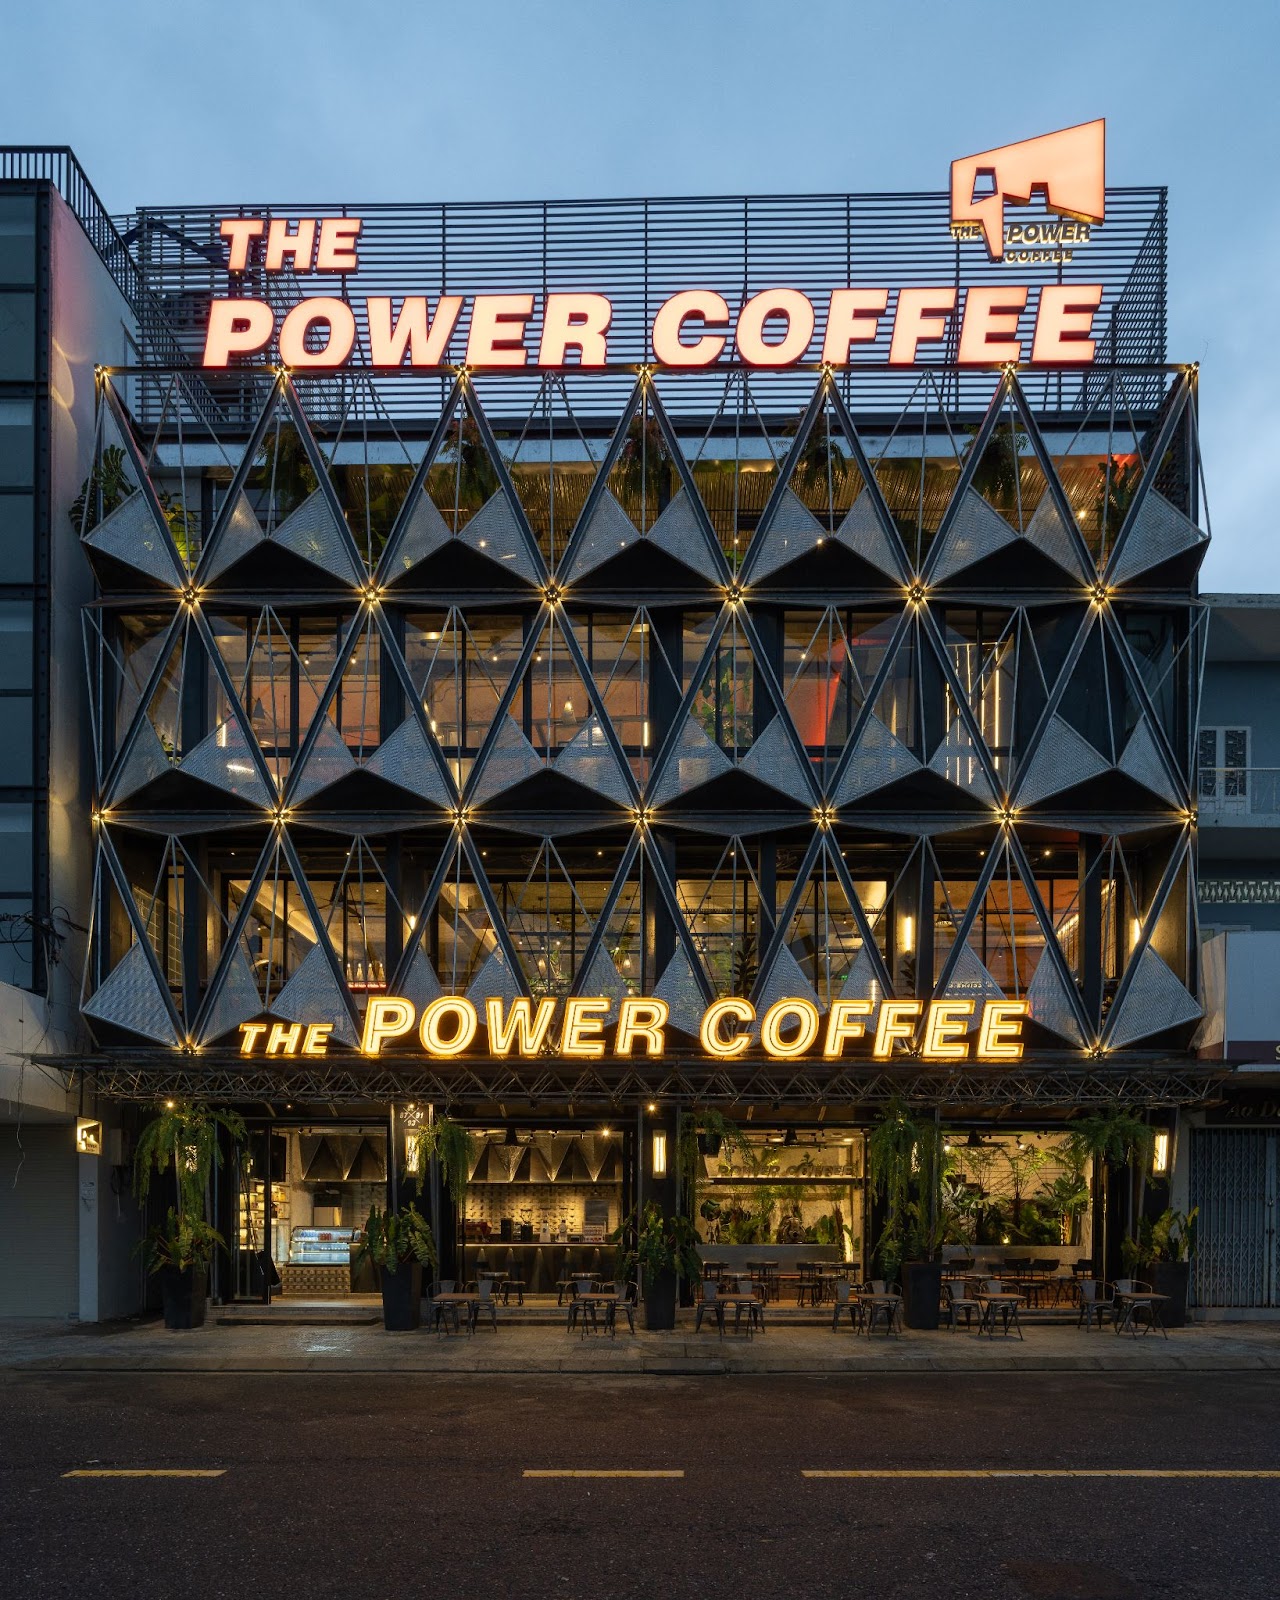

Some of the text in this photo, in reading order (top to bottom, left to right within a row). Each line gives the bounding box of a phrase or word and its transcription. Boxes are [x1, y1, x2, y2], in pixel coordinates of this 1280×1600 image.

[220, 218, 363, 274] THE
[951, 223, 1091, 245] THE POWER
[1005, 249, 1073, 264] COFFEE
[202, 285, 1104, 367] POWER COFFEE
[239, 995, 1030, 1057] THE POWER COFFEE
